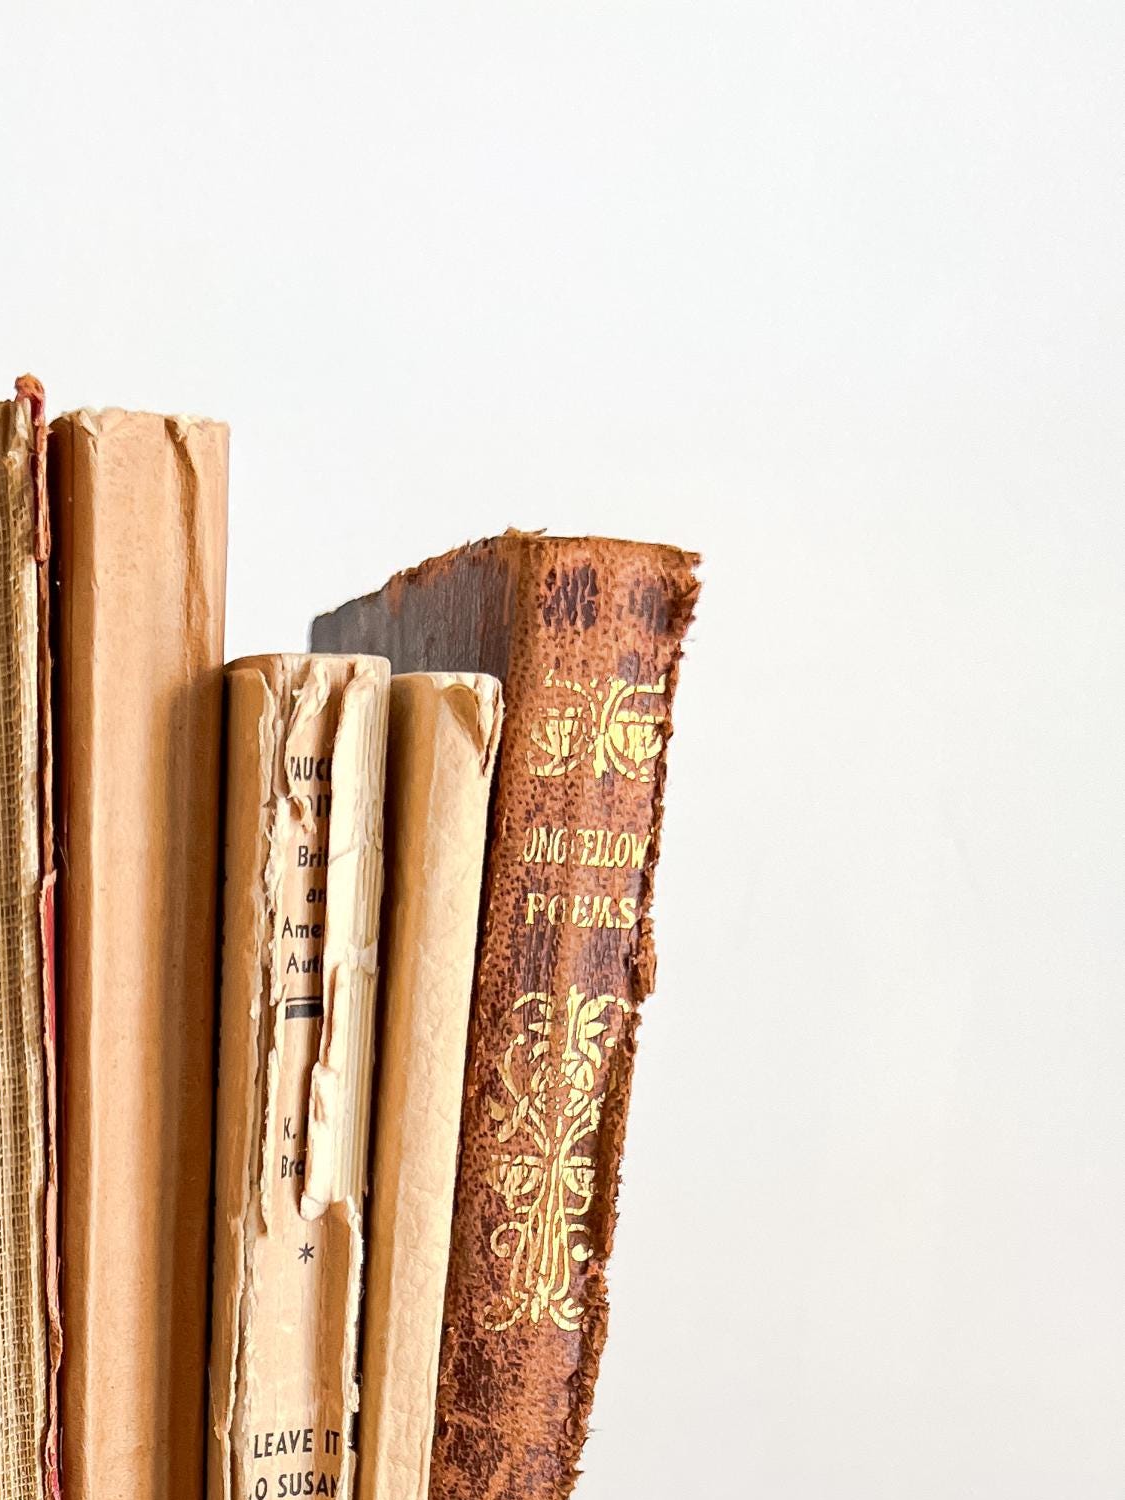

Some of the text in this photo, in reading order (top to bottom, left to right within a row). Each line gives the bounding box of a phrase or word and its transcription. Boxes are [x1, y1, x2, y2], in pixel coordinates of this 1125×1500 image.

[525, 892, 638, 929] POEMS
[253, 1428, 340, 1459] LEAVE IT
[248, 1476, 268, 1500] O
